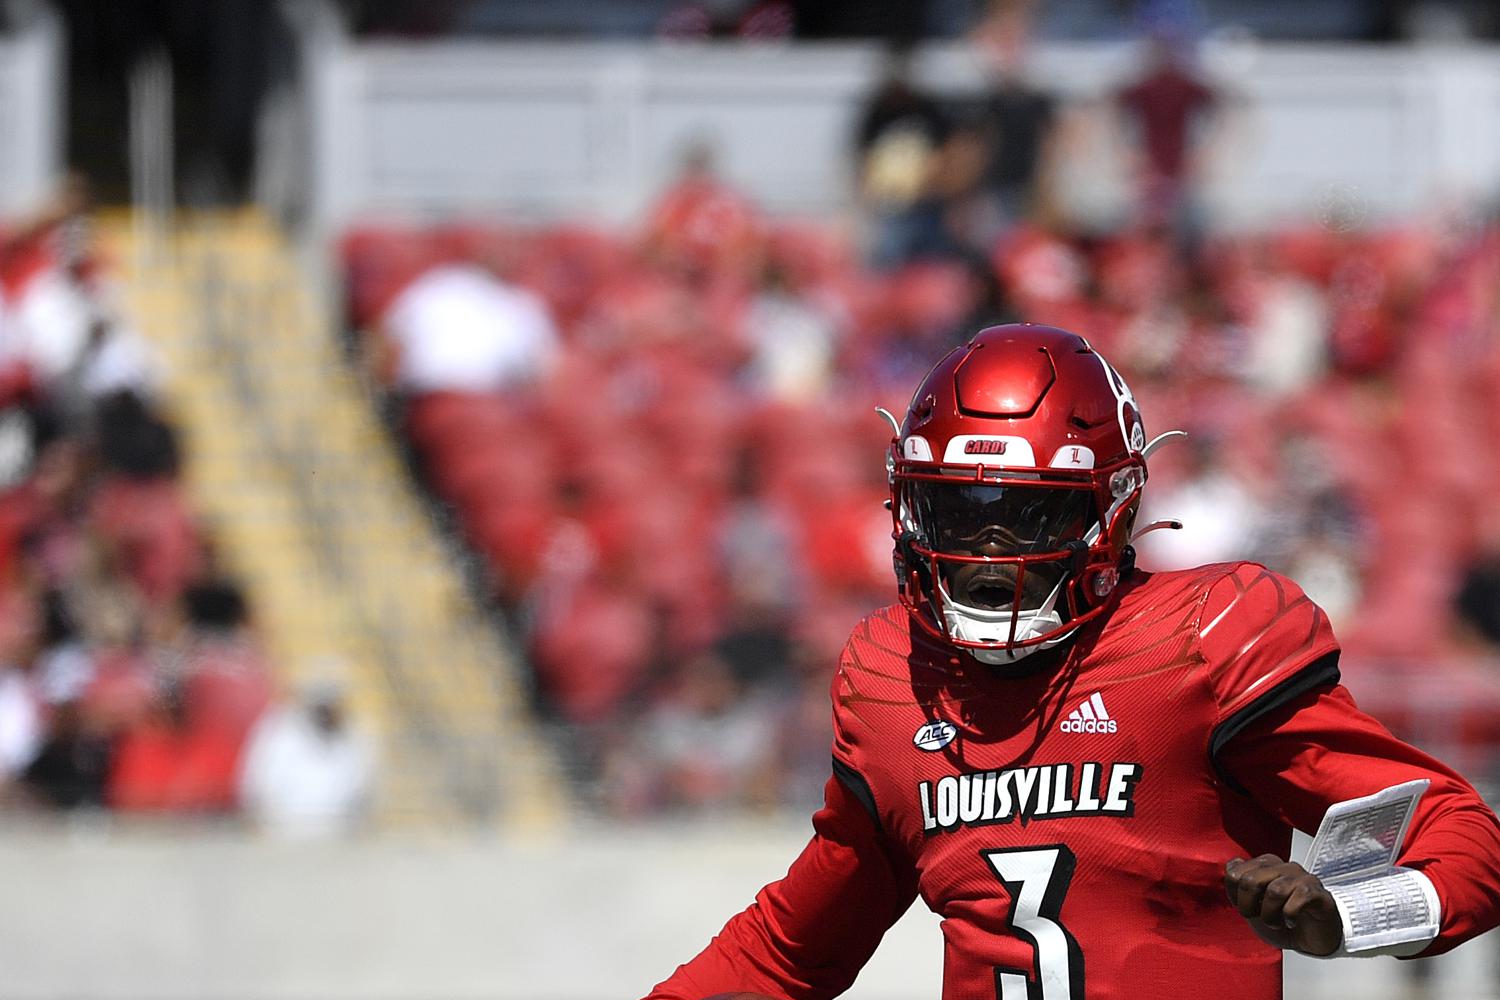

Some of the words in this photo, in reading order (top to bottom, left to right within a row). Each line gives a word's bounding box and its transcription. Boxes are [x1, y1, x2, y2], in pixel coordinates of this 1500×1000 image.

[964, 440, 1007, 455] CARDS
[1071, 448, 1081, 464] L
[919, 725, 952, 742] ACC
[1060, 717, 1118, 734] adidas
[918, 762, 1140, 835] LOUISVILLE
